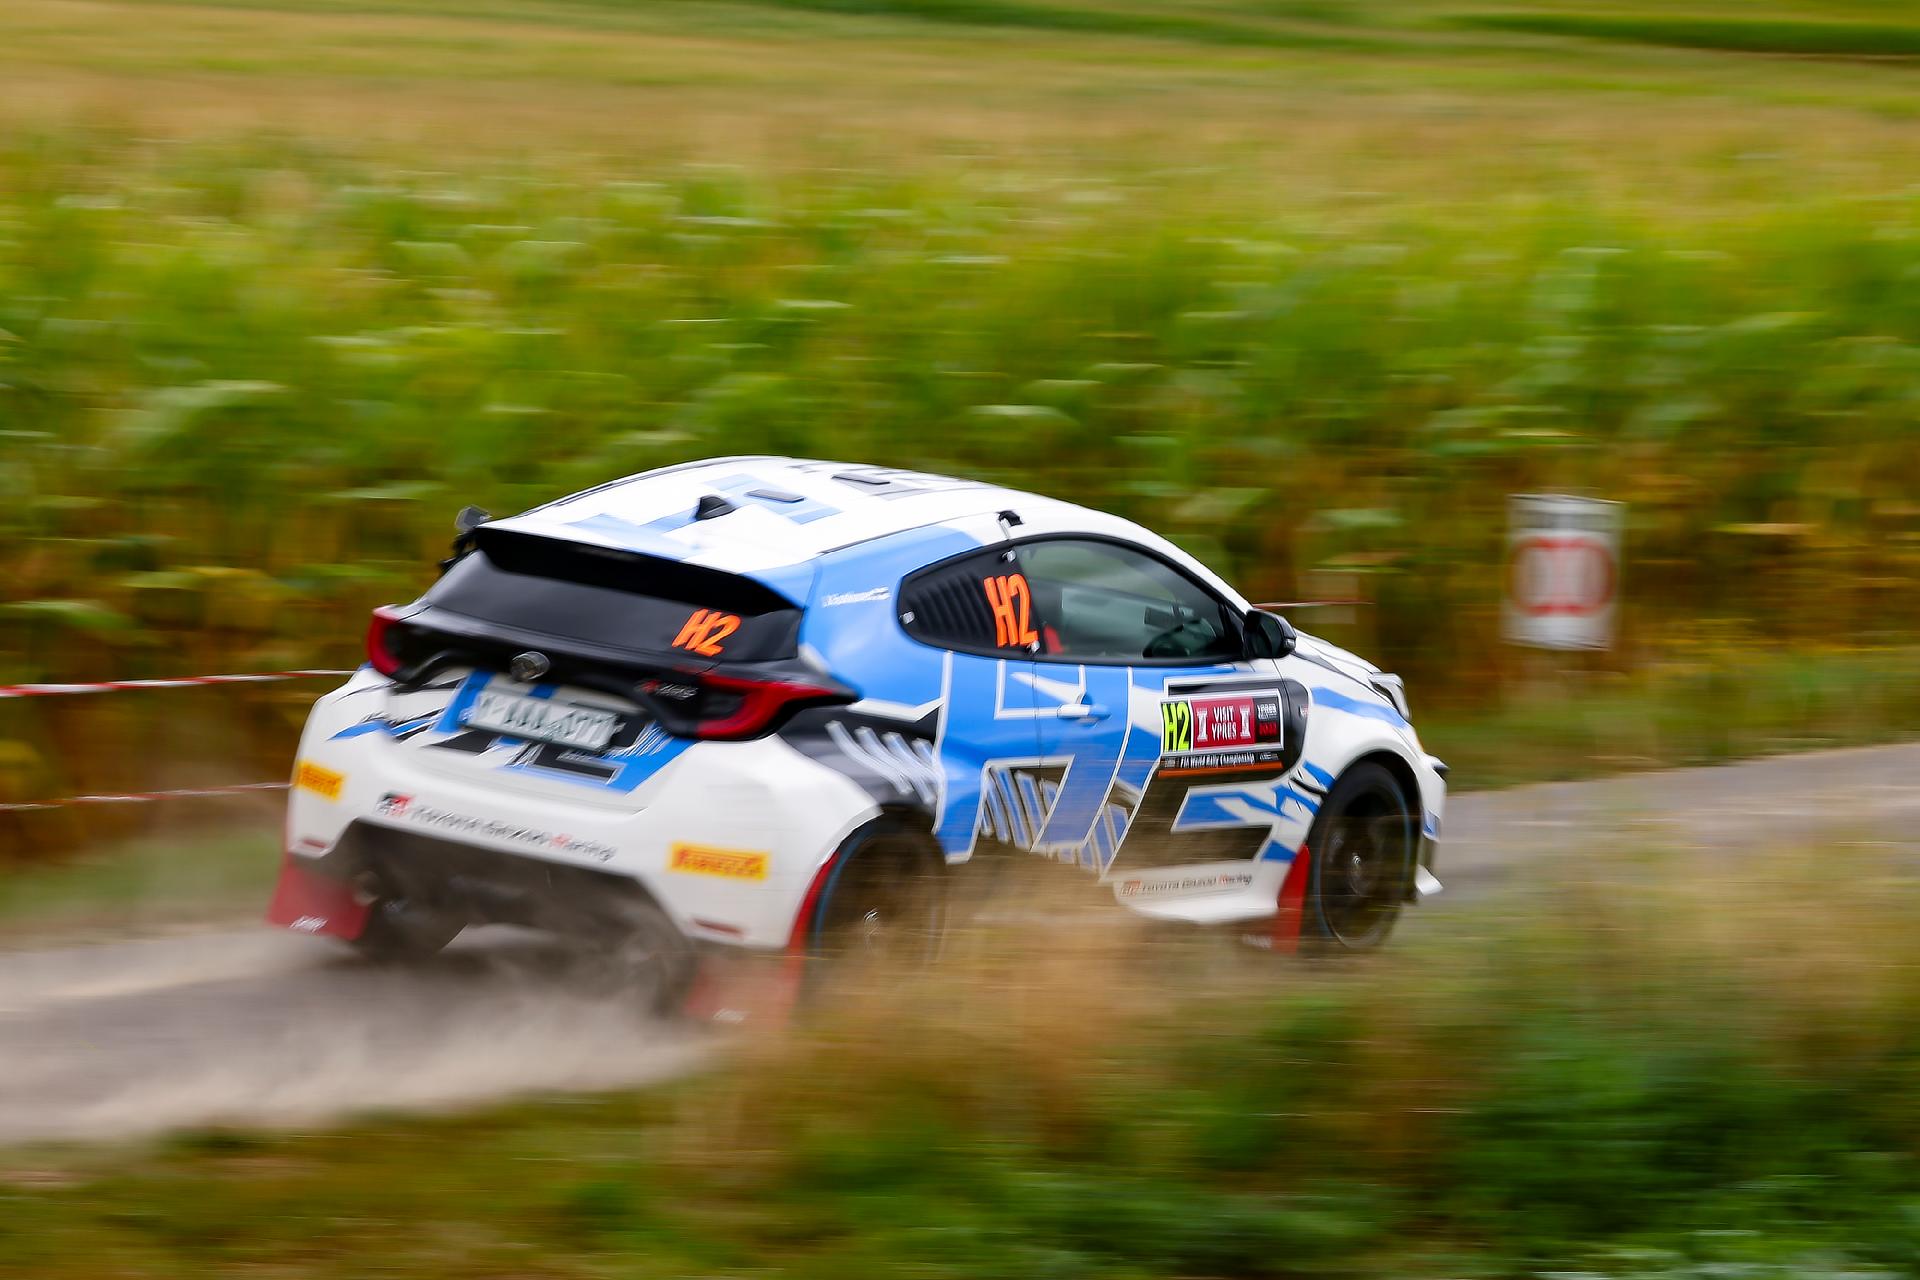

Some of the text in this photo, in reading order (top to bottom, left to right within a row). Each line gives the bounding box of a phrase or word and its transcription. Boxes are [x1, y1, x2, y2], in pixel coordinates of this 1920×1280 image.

[672, 608, 741, 657] H2
[984, 573, 1038, 648] H2
[1162, 702, 1190, 752] H2
[1213, 705, 1234, 722] VISIT
